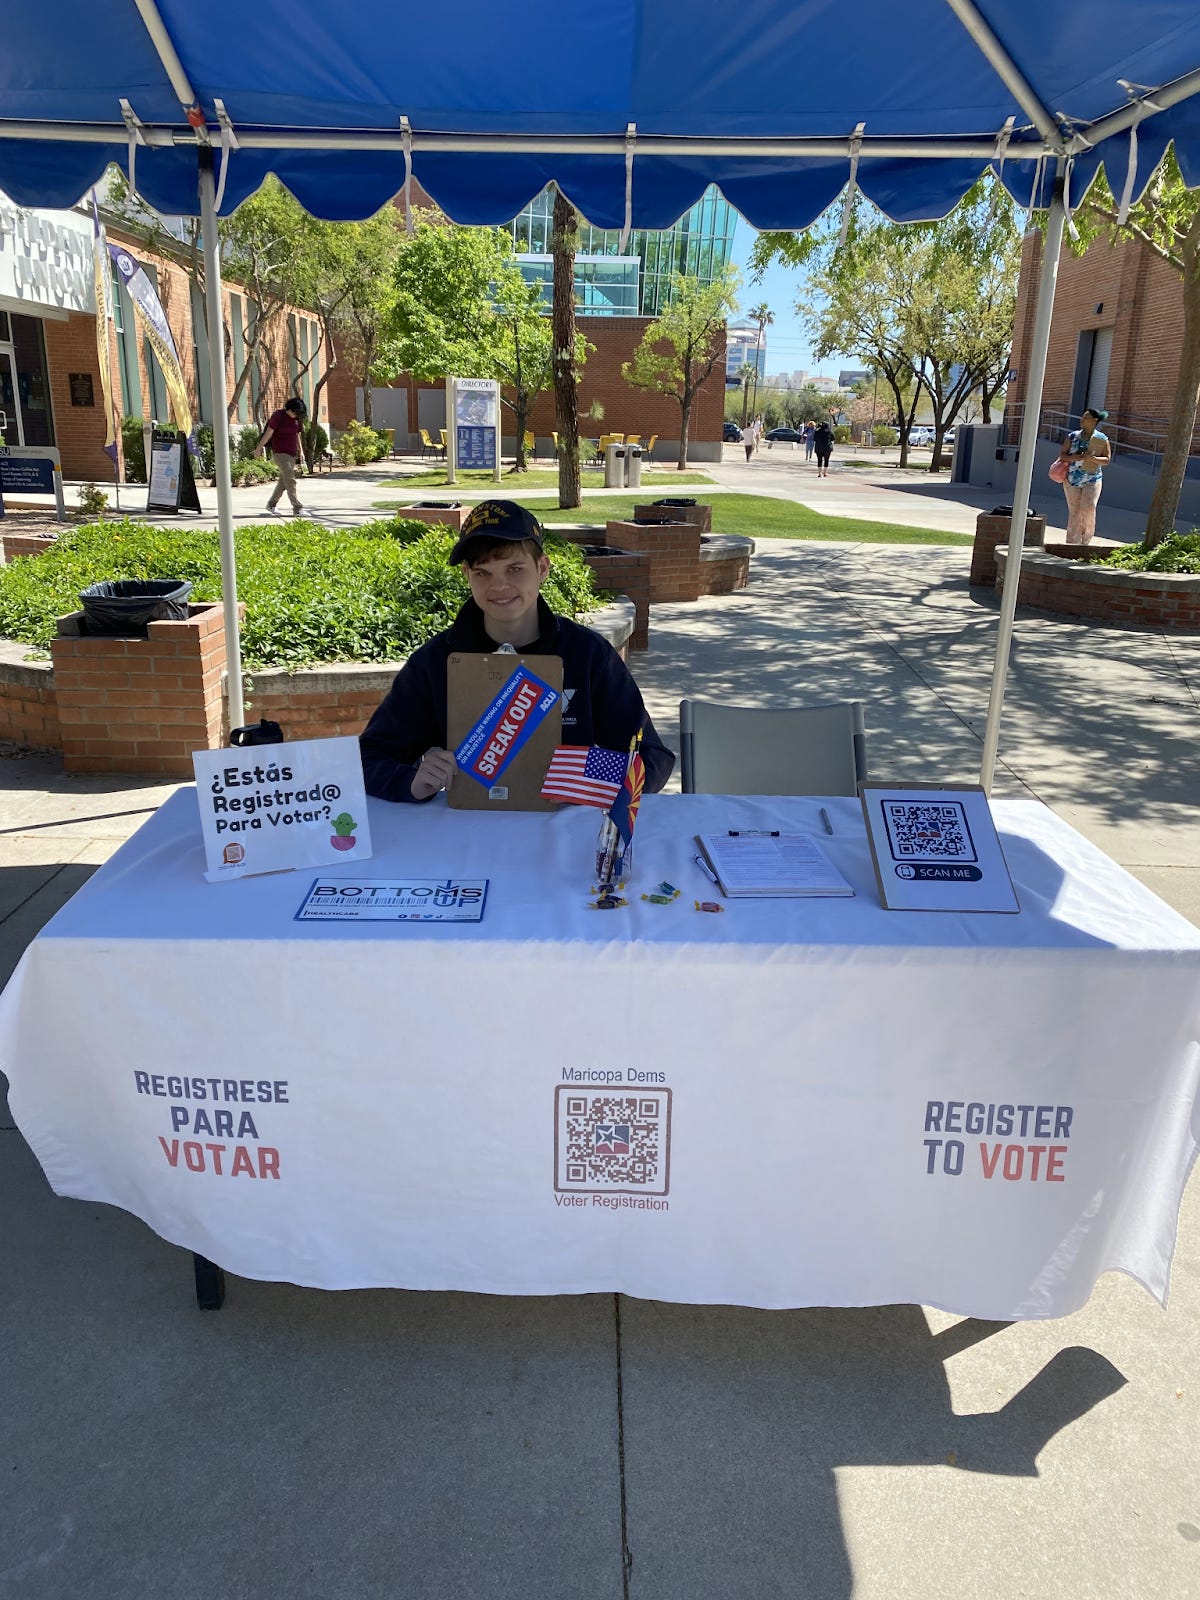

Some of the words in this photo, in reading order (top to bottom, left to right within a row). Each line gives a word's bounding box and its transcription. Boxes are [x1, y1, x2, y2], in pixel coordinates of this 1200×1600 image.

[14, 256, 86, 299] UNION
[462, 380, 492, 388] DIRECTORY
[456, 742, 471, 761] WHERE
[468, 731, 479, 744] YOU
[475, 723, 485, 736] SEE
[482, 706, 498, 725] WRONG
[495, 698, 504, 708] OR
[500, 671, 524, 700] INEQUALITY
[539, 691, 557, 712] ACLU
[478, 719, 519, 775] SPEAK
[509, 683, 537, 722] OUT
[460, 755, 469, 765] OR
[466, 733, 486, 757] INJUSTICE
[211, 763, 293, 794] ¿Estás
[213, 784, 341, 815] Registrad@
[216, 817, 262, 834] Para
[266, 805, 332, 827] Votar?
[919, 868, 950, 878] SCAN
[953, 869, 971, 878] ME
[313, 886, 482, 898] BOTTOMS
[433, 897, 480, 907] UP
[133, 1070, 290, 1104] REGISTRESE
[562, 1067, 623, 1084] Maricopa
[627, 1068, 666, 1083] Dems
[170, 1106, 260, 1139] PARA
[924, 1101, 1074, 1139] REGISTER
[157, 1136, 281, 1180] VOTAR
[923, 1139, 965, 1176] TO
[979, 1142, 1068, 1182] VOTE
[554, 1194, 588, 1207] Voter
[592, 1195, 669, 1211] Registration
